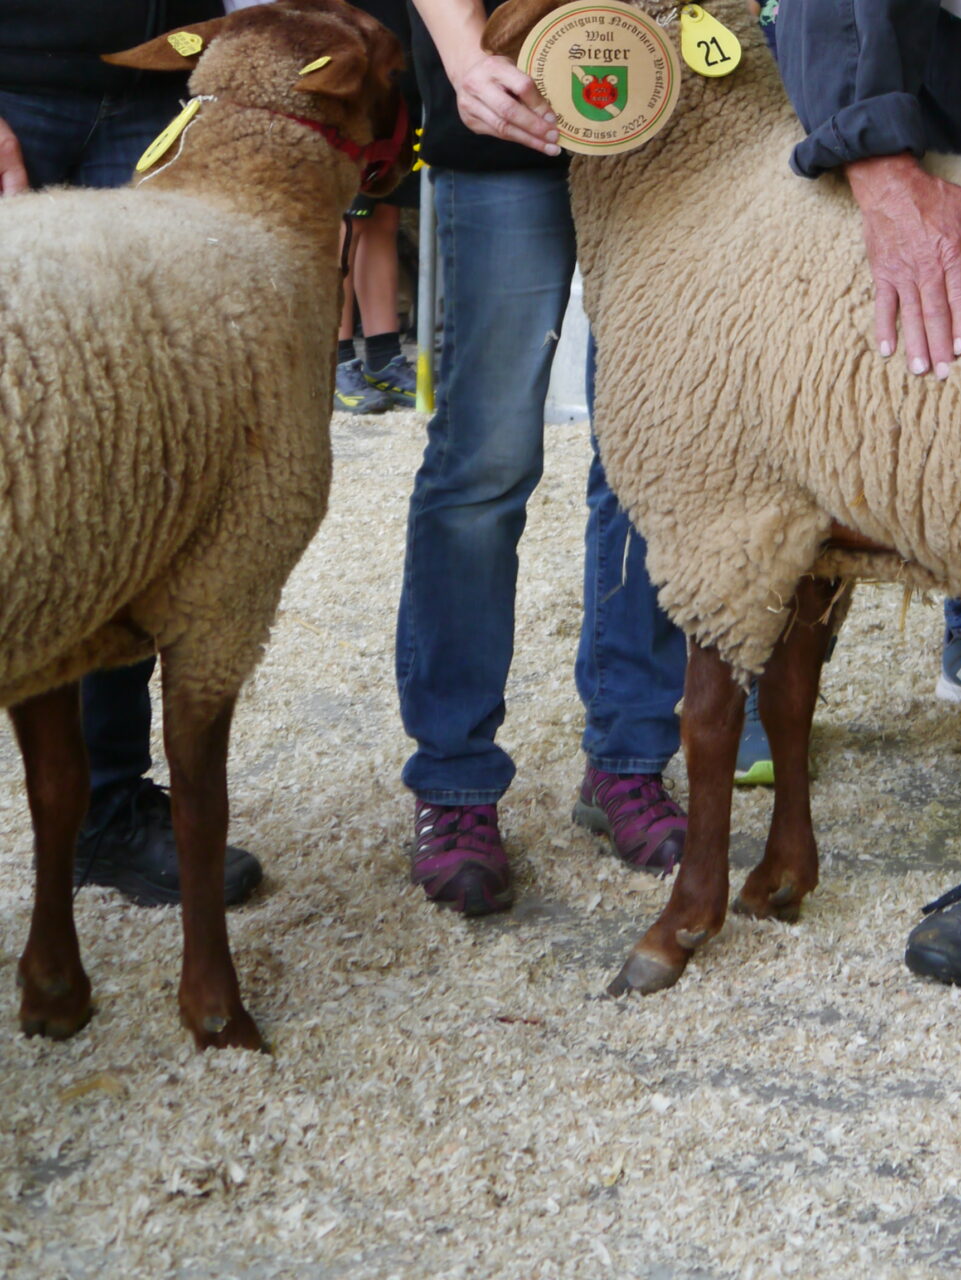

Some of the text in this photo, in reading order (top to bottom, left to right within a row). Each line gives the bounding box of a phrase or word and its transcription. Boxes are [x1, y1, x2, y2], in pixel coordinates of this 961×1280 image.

[585, 30, 614, 42] Woll
[568, 43, 631, 63] Sieger
[696, 36, 732, 67] 21
[621, 114, 648, 136] 2022
